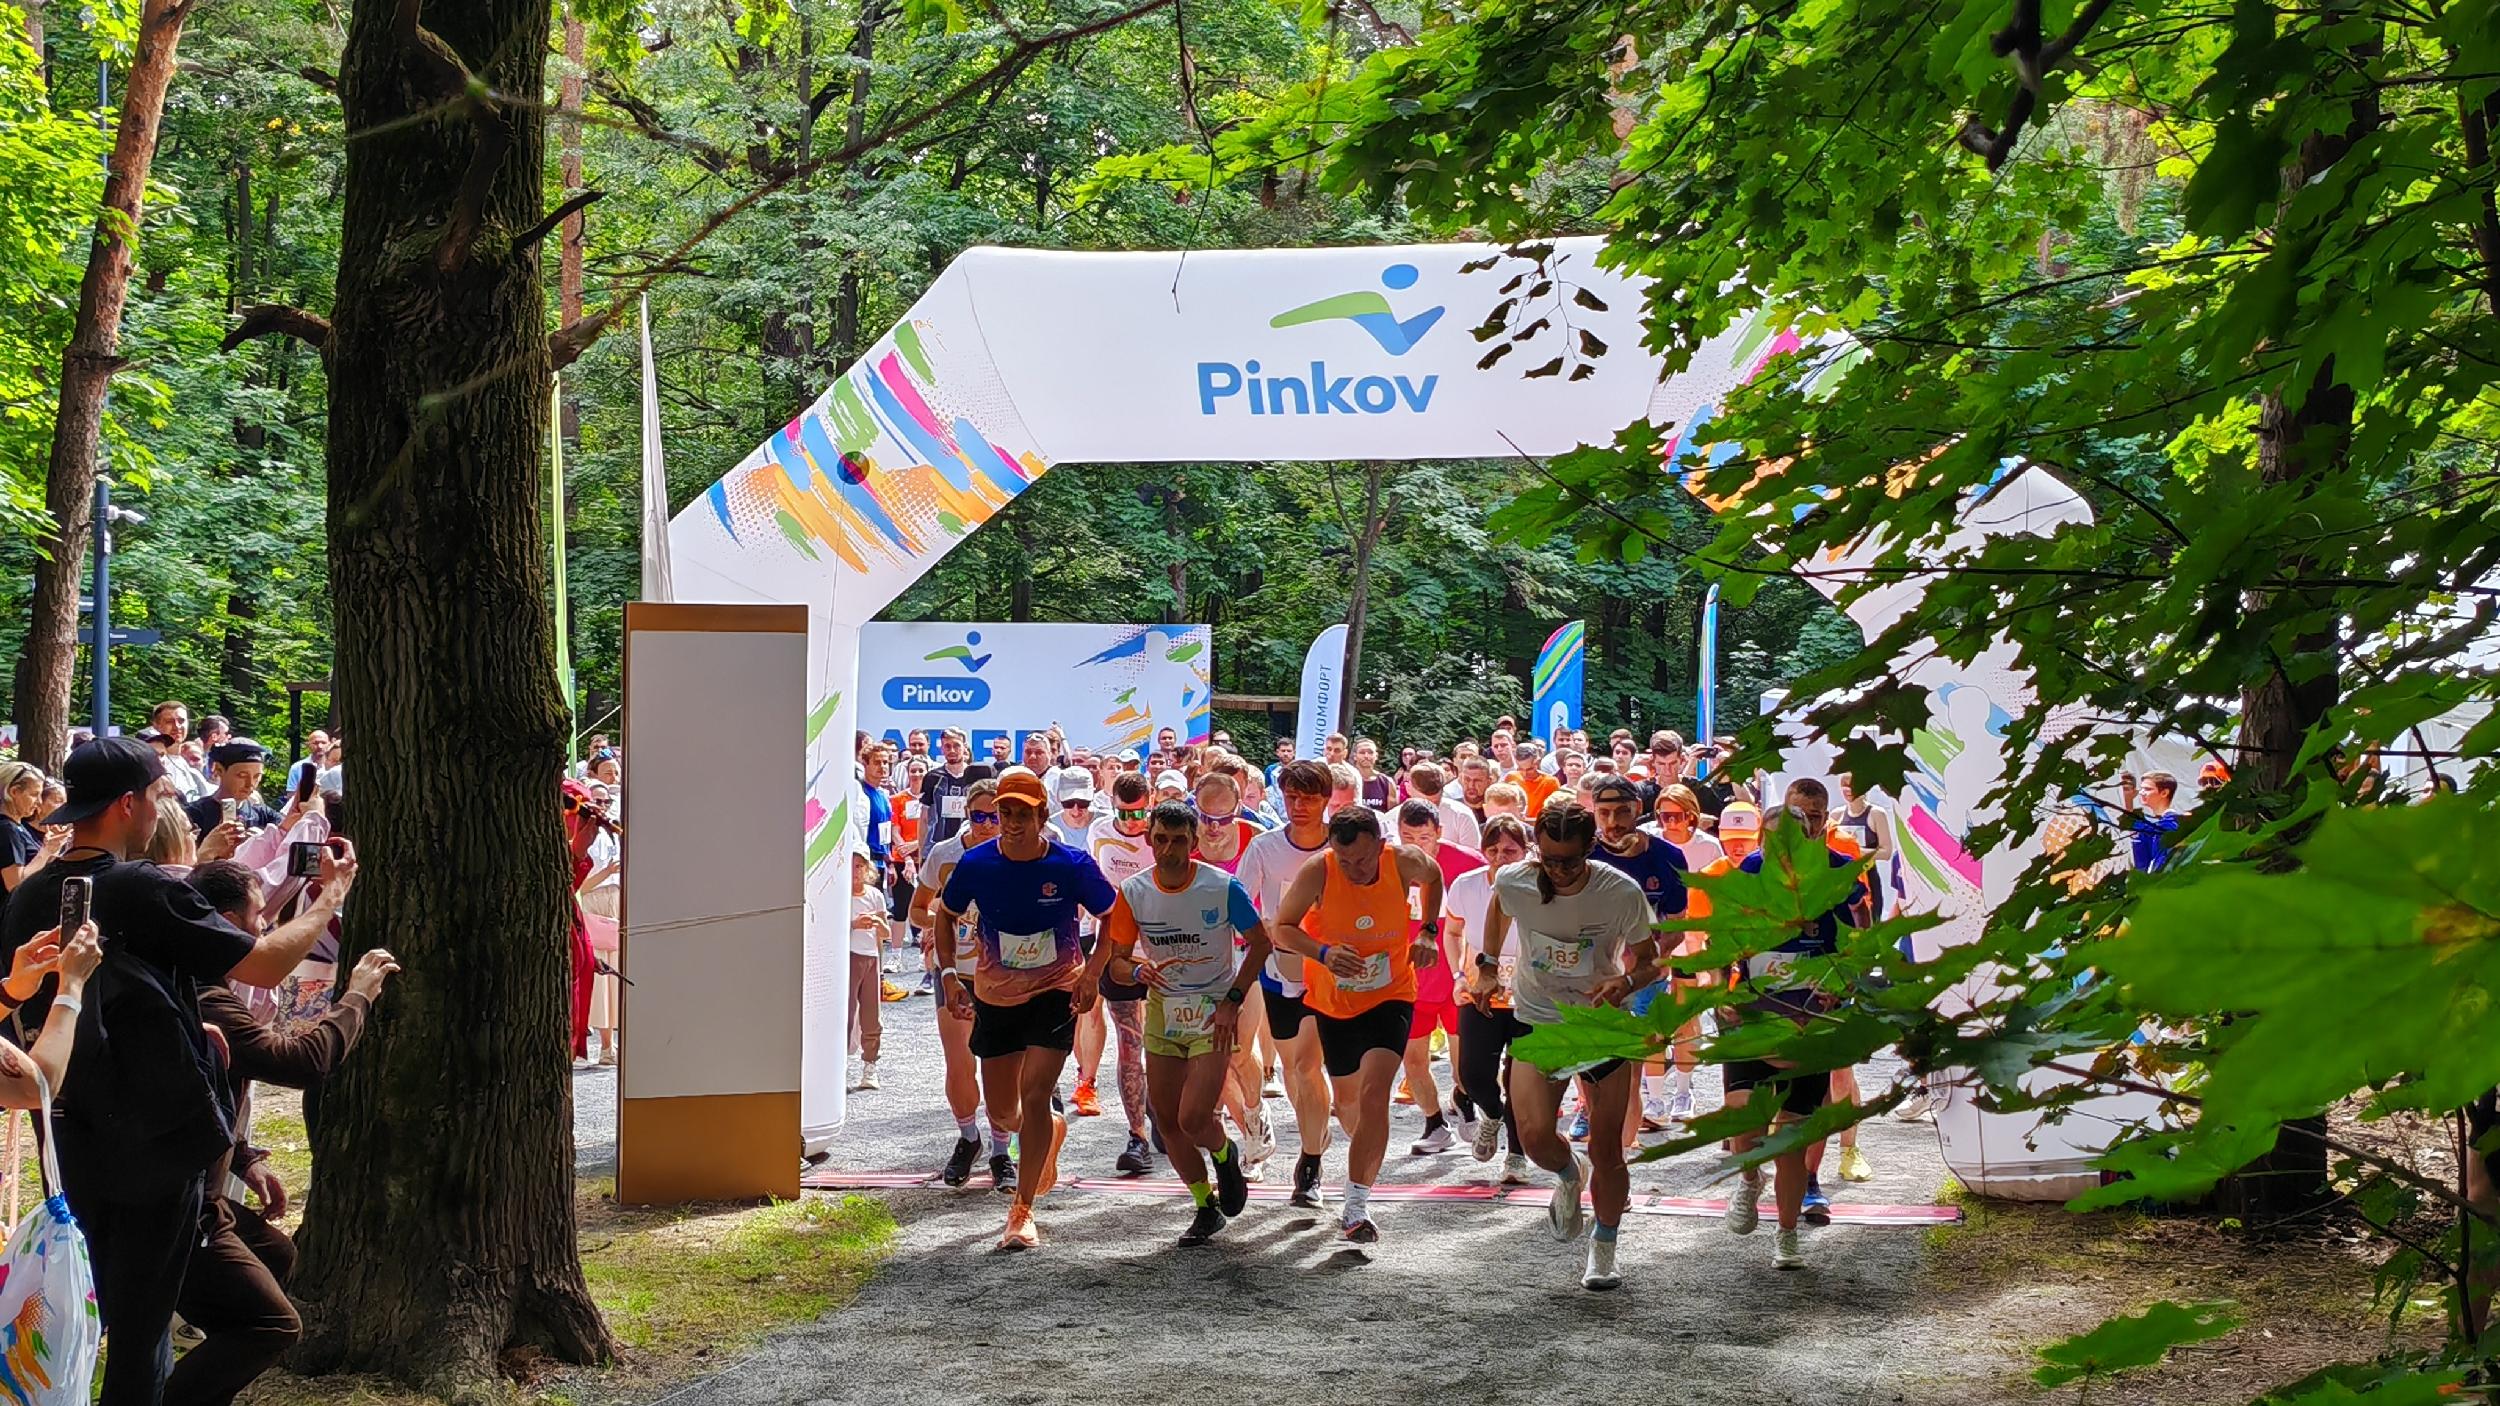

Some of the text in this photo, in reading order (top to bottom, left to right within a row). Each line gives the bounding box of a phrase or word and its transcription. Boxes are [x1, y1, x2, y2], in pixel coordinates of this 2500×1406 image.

[1197, 359, 1438, 415] Pinkov
[902, 684, 974, 703] Pinkov
[1015, 942, 1039, 956] 44
[1545, 945, 1580, 965] 183
[1174, 1005, 1204, 1023] 204
